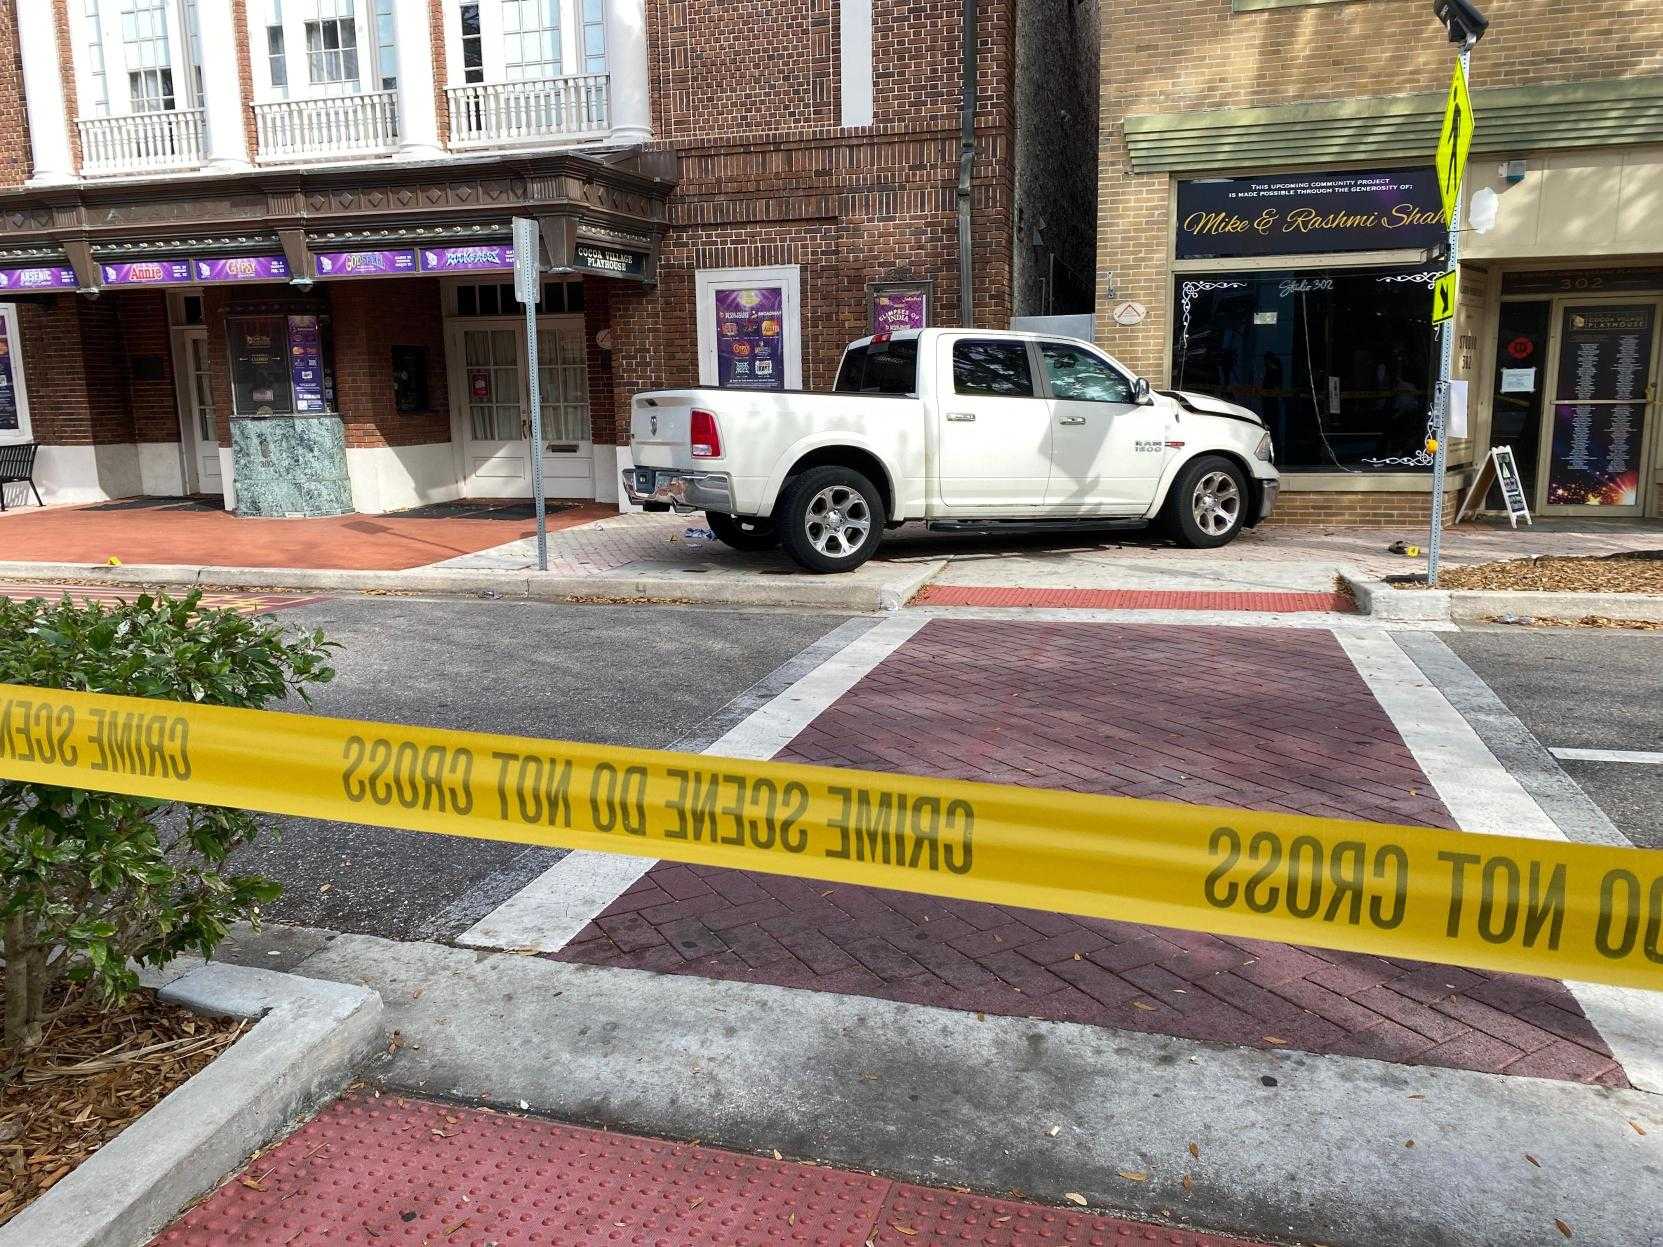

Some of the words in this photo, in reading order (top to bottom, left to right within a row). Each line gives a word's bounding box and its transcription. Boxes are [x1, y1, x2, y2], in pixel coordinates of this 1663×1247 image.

[1260, 189, 1295, 197] POSSIBLE
[1297, 187, 1333, 195] THROUGH
[1351, 184, 1398, 192] GENEROSITY
[1271, 182, 1309, 190] UPCOMING
[1311, 180, 1355, 188] COMMUNITY
[1183, 211, 1250, 236] Mike
[1253, 208, 1280, 235] &
[1282, 207, 1379, 233] Rashmi
[578, 247, 602, 259] COCOA
[605, 251, 633, 264] VILLAGE
[227, 259, 257, 274] GYPSY
[587, 258, 626, 271] PLAYHOUSE
[130, 266, 162, 280] Annie
[1313, 279, 1333, 290] 302
[1560, 278, 1602, 289] 302
